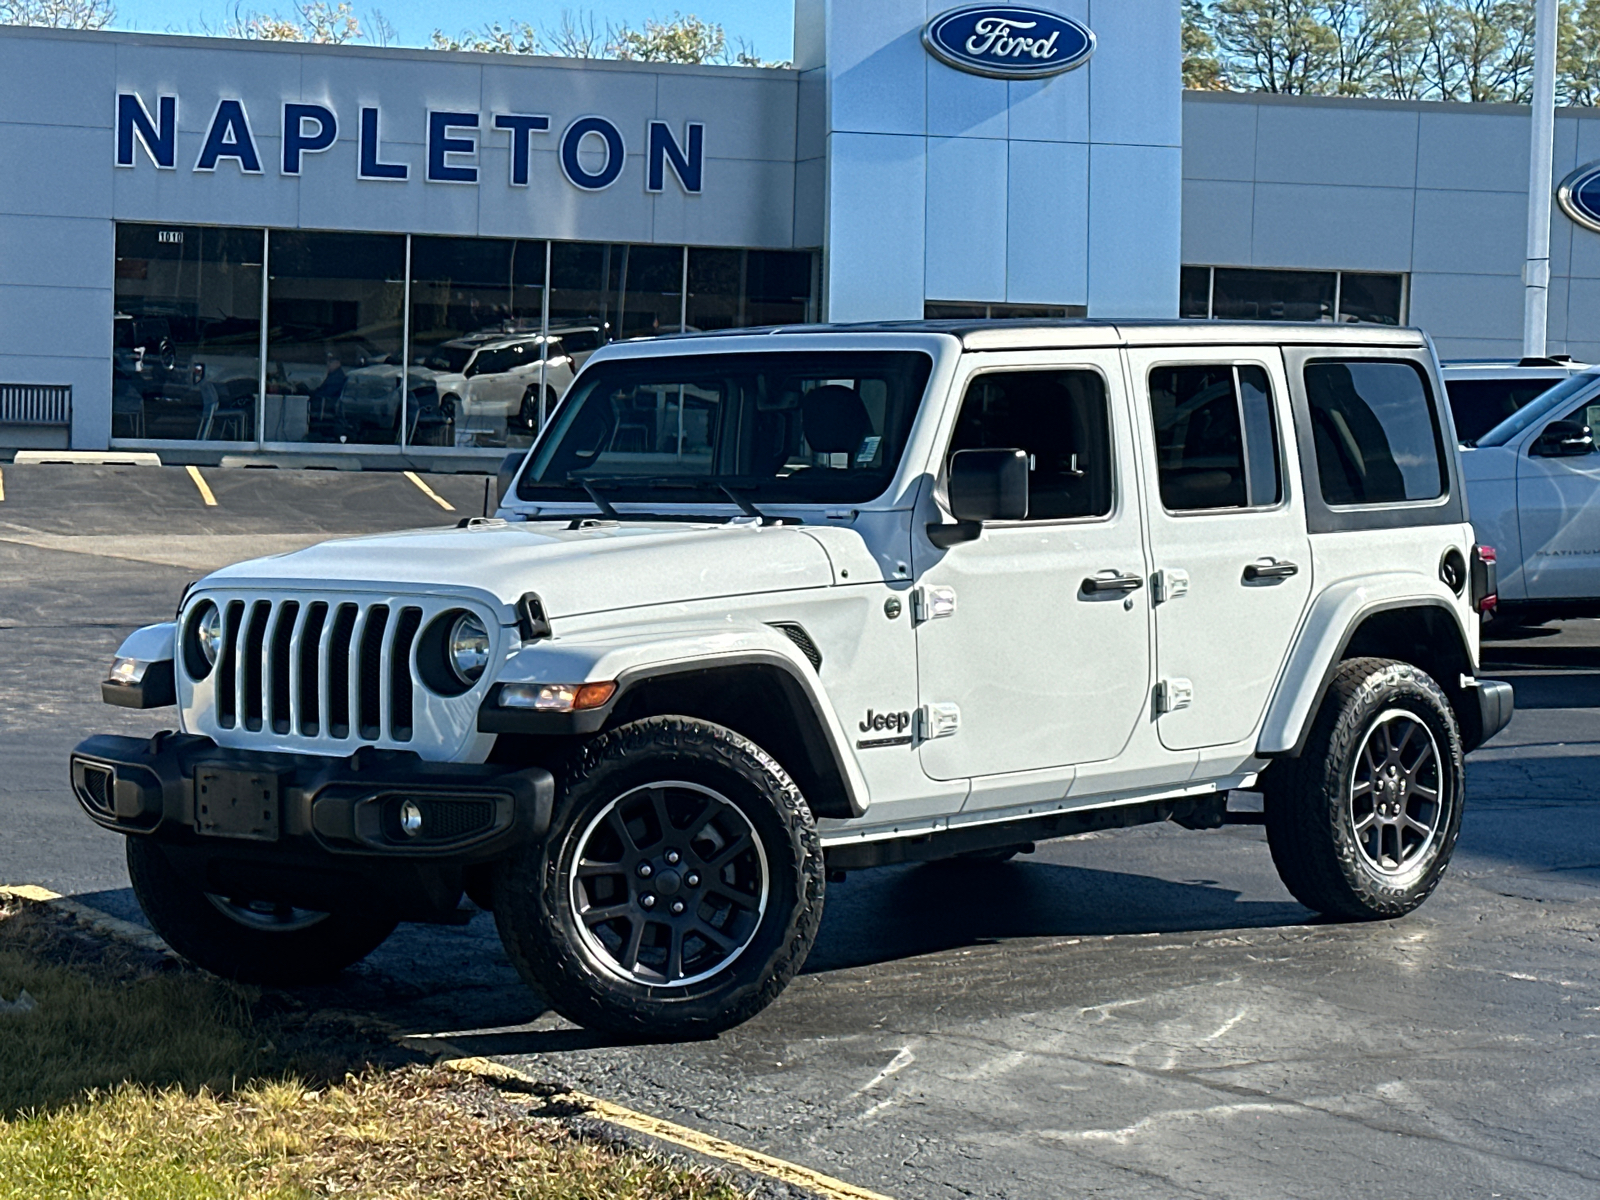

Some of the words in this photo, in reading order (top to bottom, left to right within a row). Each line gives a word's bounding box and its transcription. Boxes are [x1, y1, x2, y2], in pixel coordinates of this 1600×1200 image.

[965, 17, 1060, 59] Ford
[115, 93, 704, 194] NAPLETON
[160, 231, 183, 243] 1010
[1536, 549, 1600, 557] PLATINUM
[858, 708, 911, 733] Jeep
